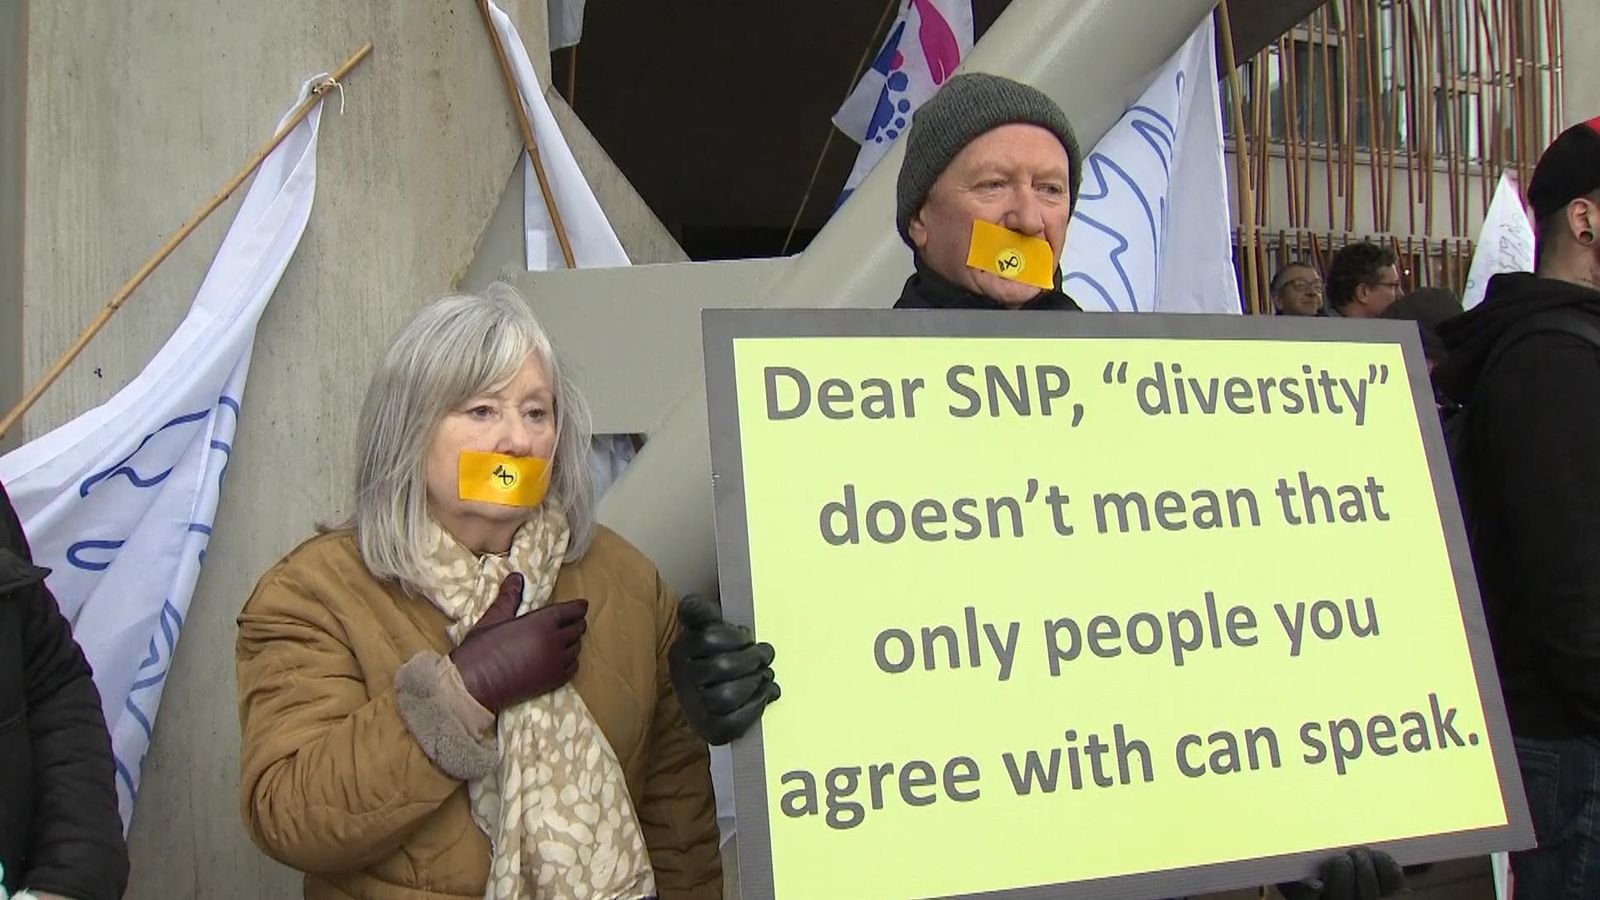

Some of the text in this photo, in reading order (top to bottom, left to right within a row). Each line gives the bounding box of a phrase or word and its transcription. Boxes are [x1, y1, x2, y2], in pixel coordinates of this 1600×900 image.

[764, 361, 1389, 428] Dear SNP, “diversity”
[819, 471, 1391, 546] doesn’t mean that
[873, 591, 1380, 682] only people you
[780, 692, 1479, 830] agree with can speak.
